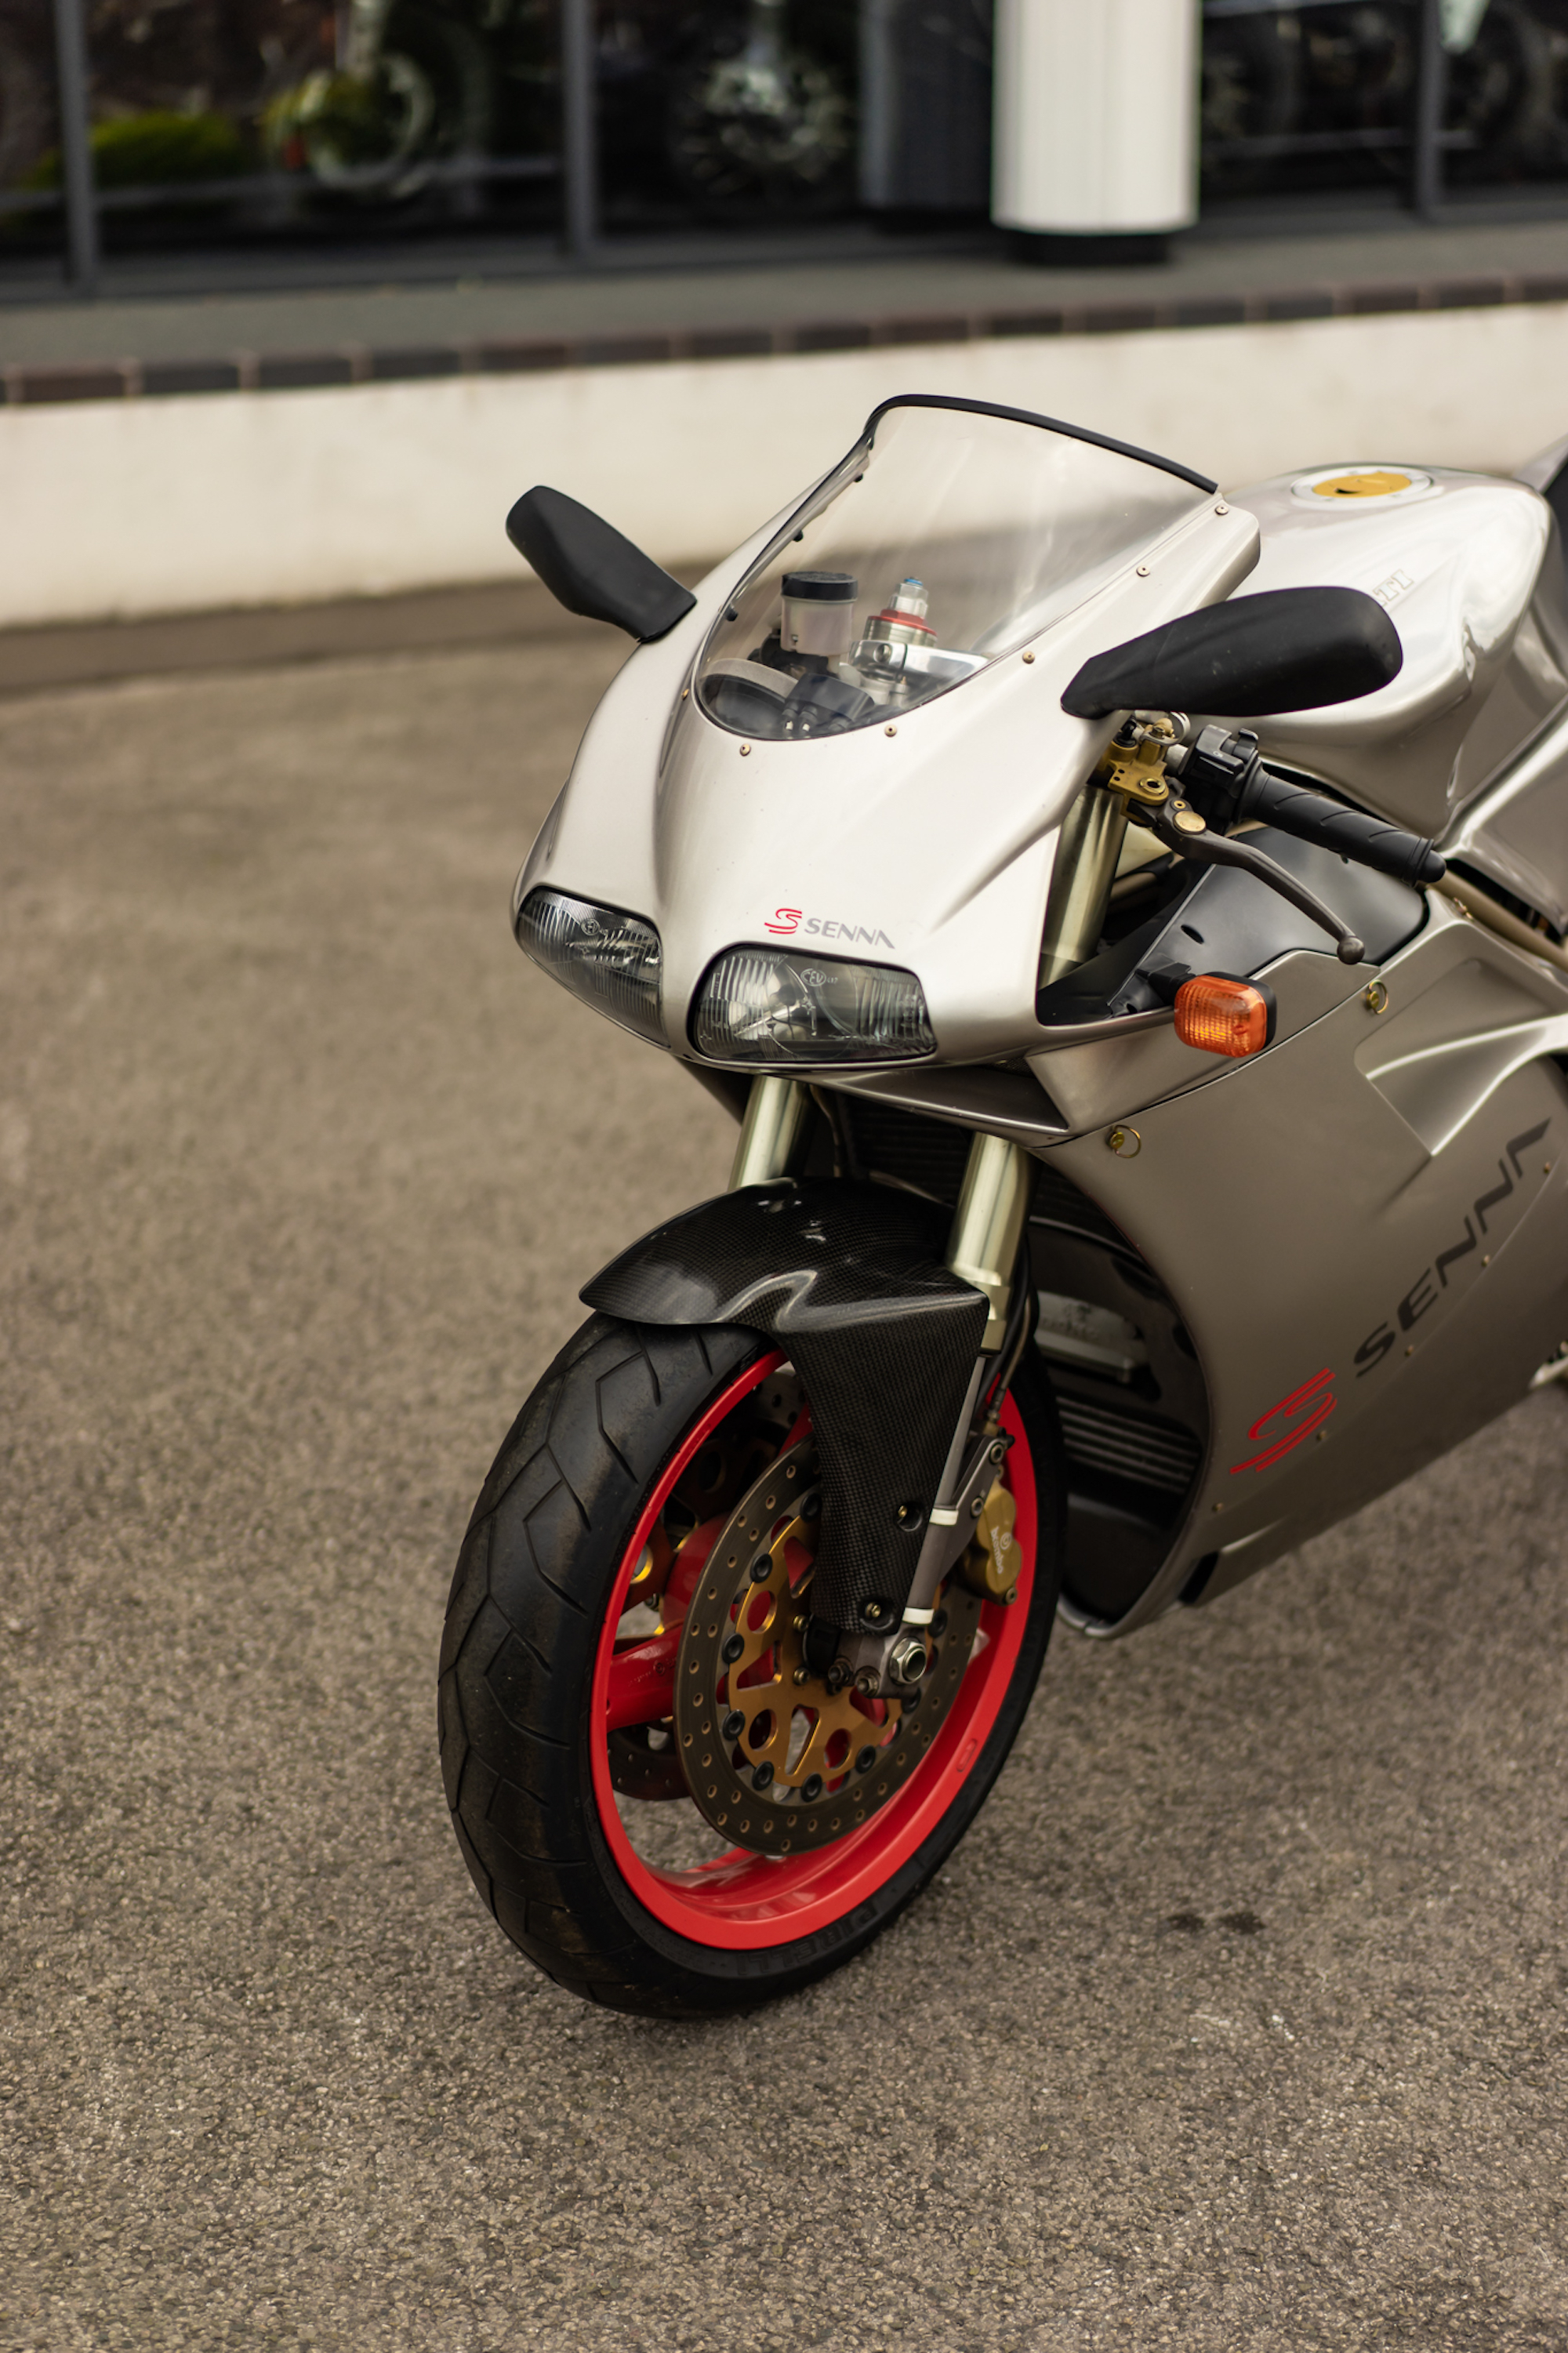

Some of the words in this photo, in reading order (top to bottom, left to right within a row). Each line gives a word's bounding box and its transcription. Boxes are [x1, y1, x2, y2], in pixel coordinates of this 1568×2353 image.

[804, 917, 895, 950] SENNA
[1354, 1117, 1552, 1378] SENNA
[990, 1526, 1004, 1574] brembo
[737, 1900, 880, 1975] PIRELLI
